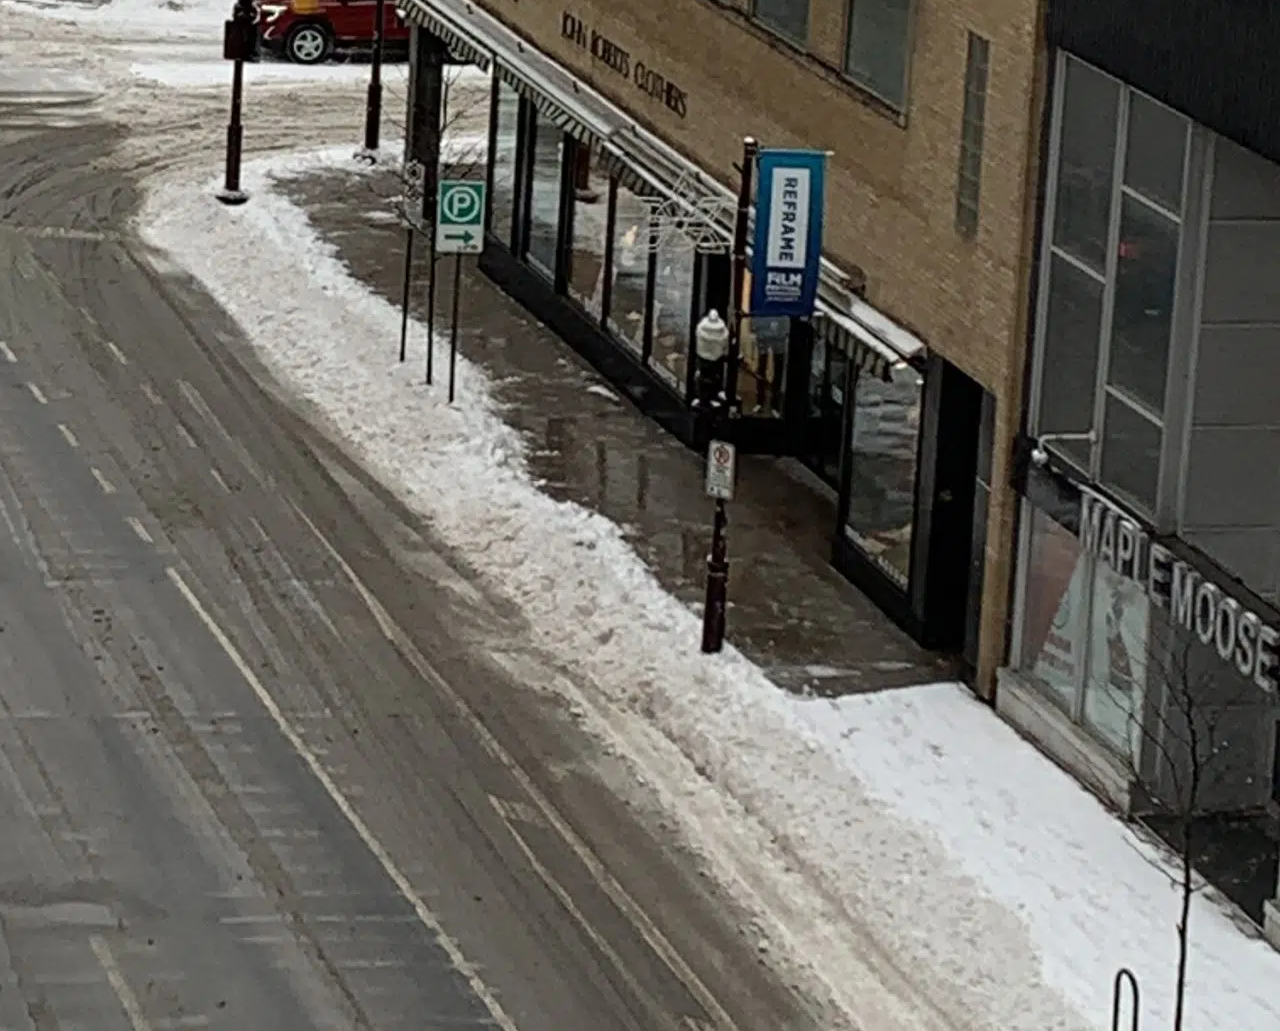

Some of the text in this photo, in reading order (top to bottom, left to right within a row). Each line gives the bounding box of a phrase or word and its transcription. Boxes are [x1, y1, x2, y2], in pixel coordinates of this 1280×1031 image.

[779, 177, 799, 262] REFRAME
[766, 272, 803, 286] FILM
[1172, 560, 1279, 693] MOOSE
